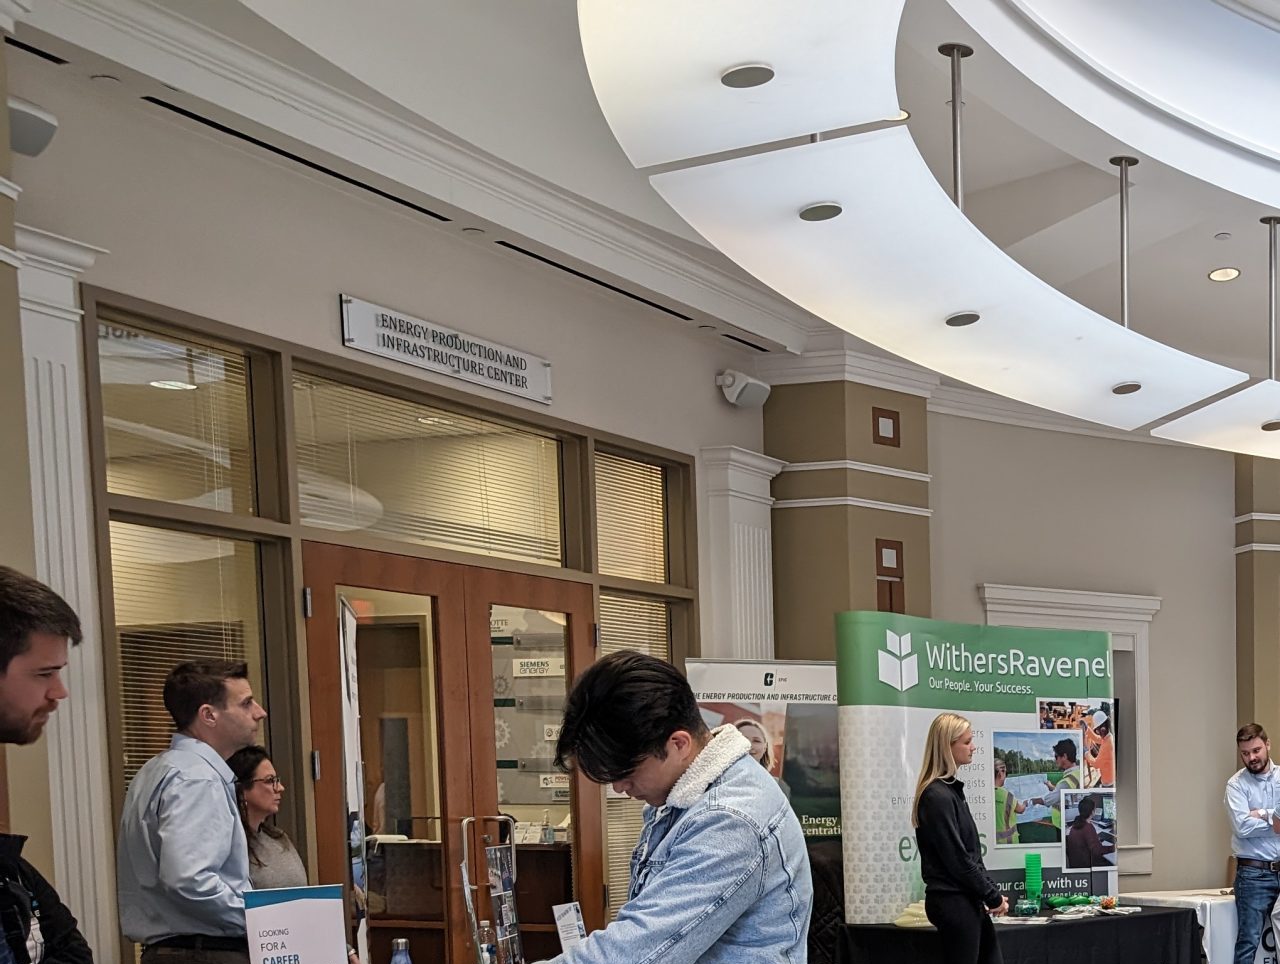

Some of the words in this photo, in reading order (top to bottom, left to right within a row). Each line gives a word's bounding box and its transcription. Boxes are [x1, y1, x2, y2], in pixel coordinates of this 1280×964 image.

[380, 313, 429, 340] ENERGY
[432, 329, 503, 363] PRODUCTION
[504, 354, 528, 371] AND
[381, 333, 485, 377] INFRASTRUCTURE
[487, 365, 529, 390] CENTER
[925, 640, 1112, 679] WithersRavenel
[928, 677, 944, 690] Our
[944, 677, 973, 693] People.
[974, 679, 995, 692] Your
[996, 681, 1035, 695] Success.
[702, 692, 726, 700] ENERGY
[727, 692, 766, 701] PRODUCTION
[766, 693, 779, 701] AND
[780, 694, 831, 702] INFRASTRUCTURE
[801, 815, 838, 827] Energy
[802, 825, 841, 836] centrati
[996, 882, 1012, 892] our
[1047, 877, 1072, 889] with
[1075, 879, 1089, 888] us
[258, 928, 289, 938] LOOKING
[260, 942, 279, 952] FOR
[280, 942, 287, 950] A
